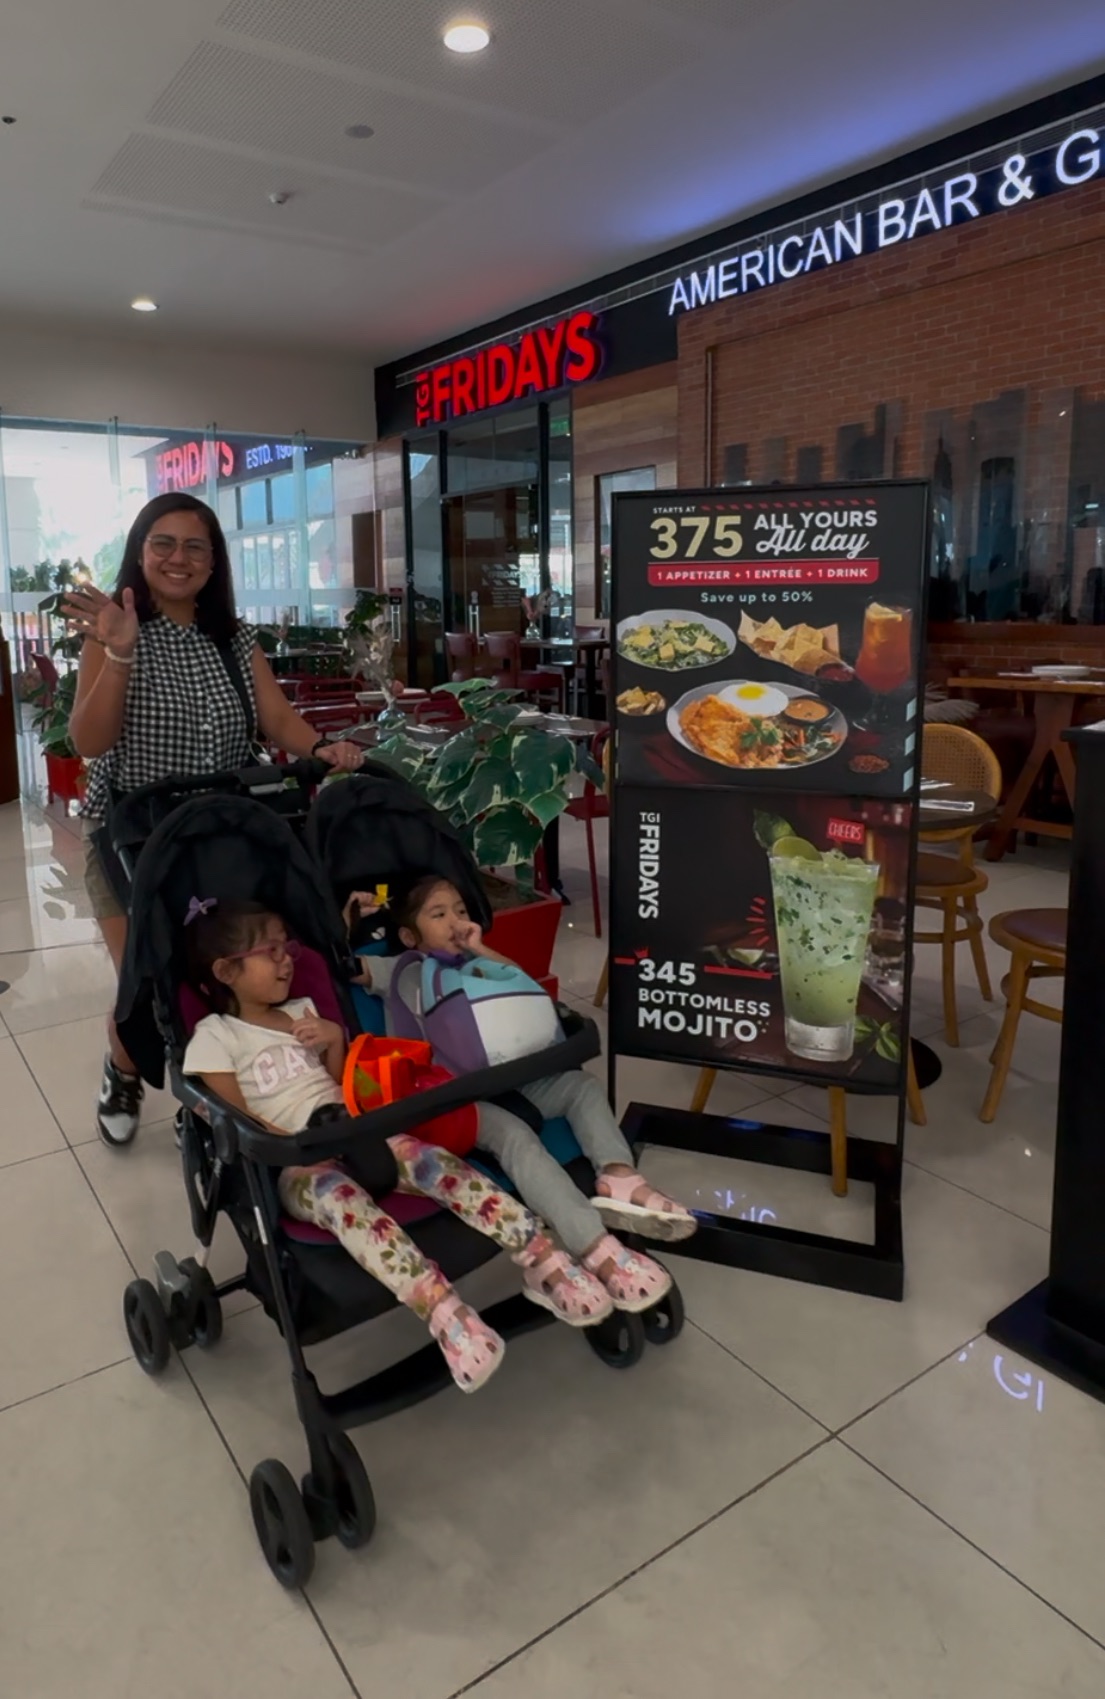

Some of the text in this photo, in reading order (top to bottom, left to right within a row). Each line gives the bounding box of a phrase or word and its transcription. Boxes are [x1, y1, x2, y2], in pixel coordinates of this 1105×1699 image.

[668, 212, 862, 316] AMERICAN
[878, 172, 979, 249] BAR
[998, 154, 1034, 207] &
[432, 311, 597, 423] FRIDAYS
[652, 505, 696, 514] STARTS AT
[753, 510, 878, 530] ALL YOURS
[649, 515, 743, 559] 375
[755, 525, 870, 560] All day
[657, 571, 663, 580] 1
[666, 570, 731, 580] APPETIZER
[745, 570, 751, 579] 1
[754, 567, 802, 579] ENTRÉE
[817, 569, 823, 578] 1
[827, 567, 869, 578] DRINK
[700, 590, 814, 606] Save up to 50%
[638, 811, 661, 919] TGI FRIDAYS
[638, 958, 697, 986] 345
[638, 988, 771, 1017] BOTTOMLESS
[638, 1007, 758, 1042] MOJITO
[252, 1045, 314, 1094] GA
